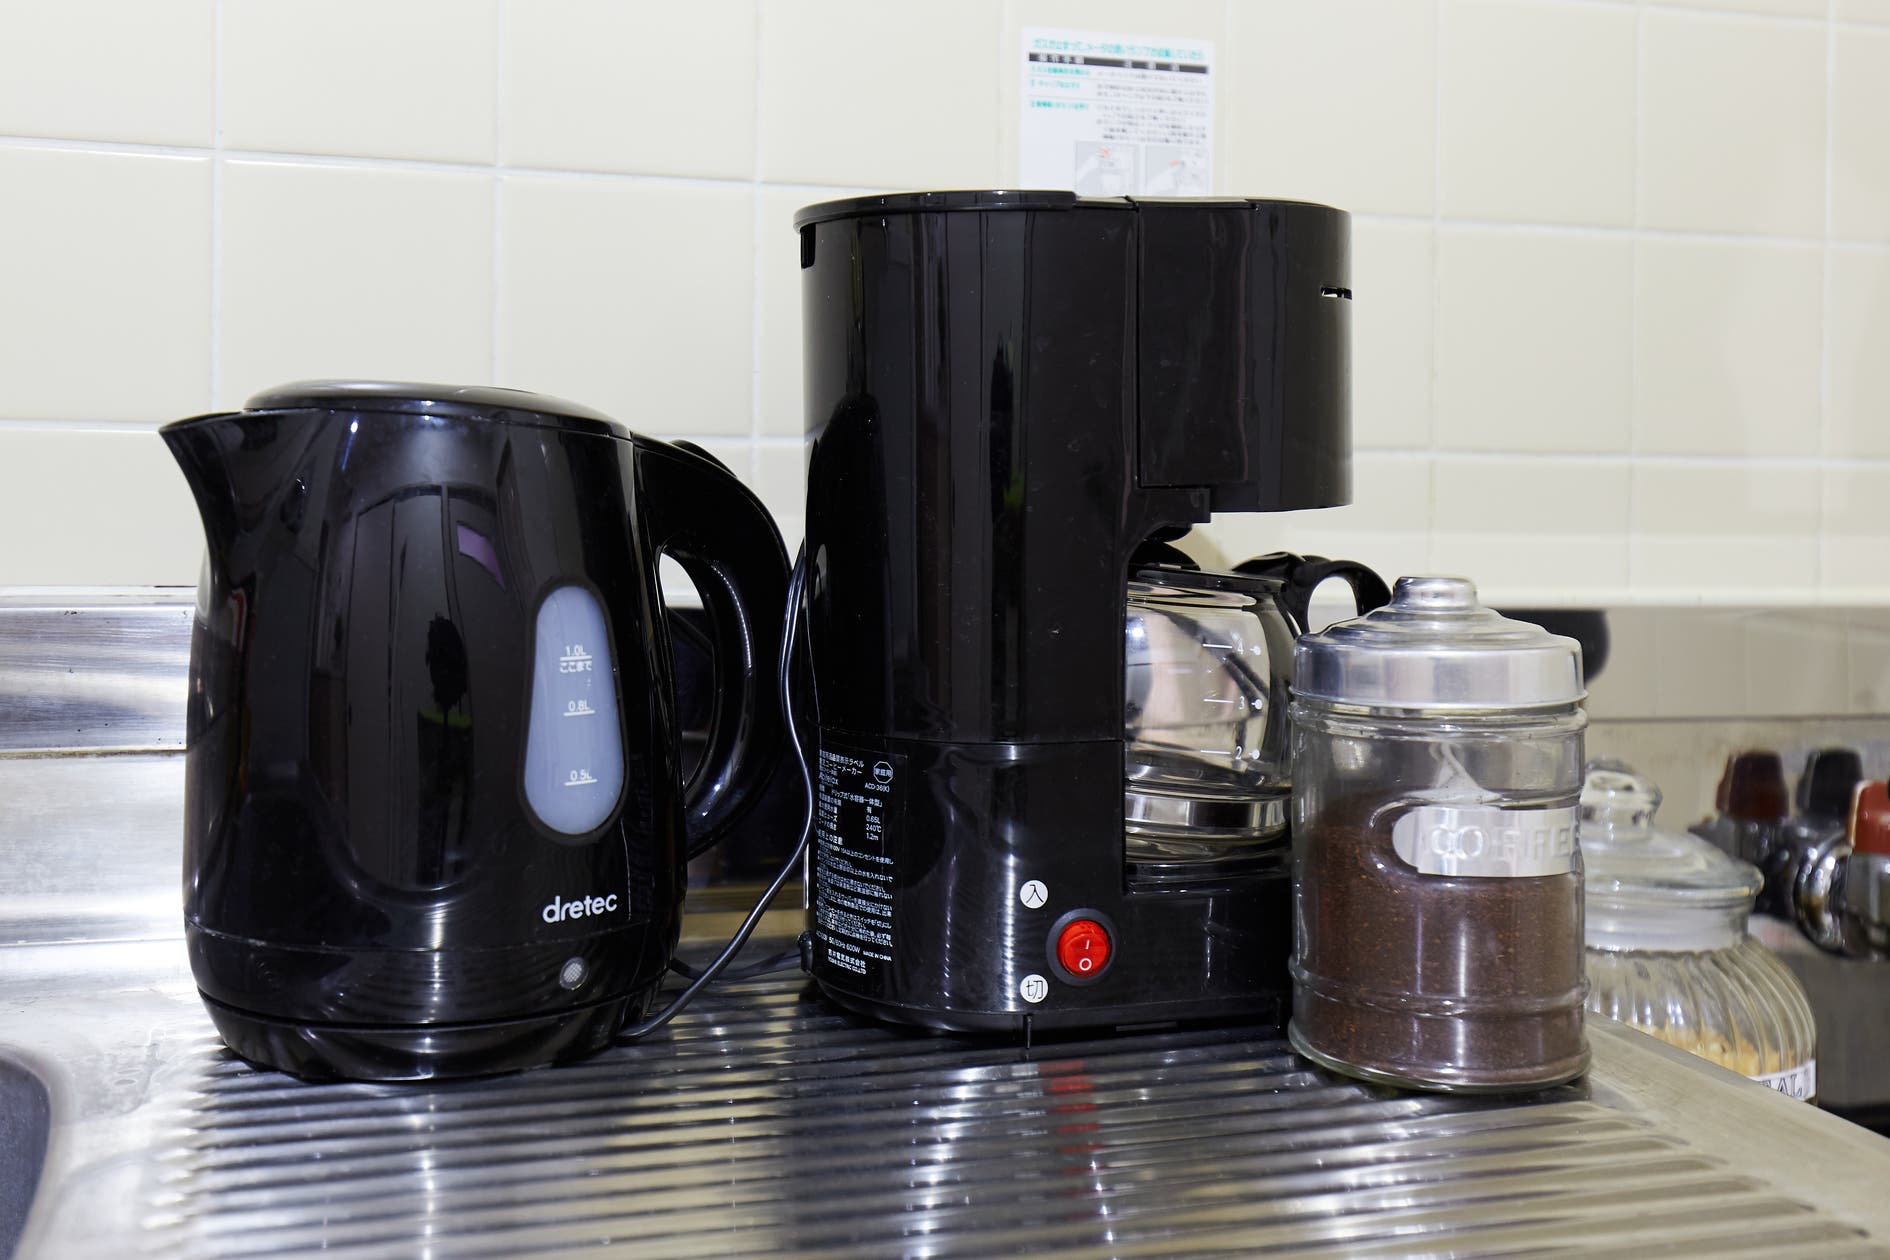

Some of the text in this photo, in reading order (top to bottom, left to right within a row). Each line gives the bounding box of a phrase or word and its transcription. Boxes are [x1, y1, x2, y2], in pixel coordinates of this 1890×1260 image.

[565, 644, 587, 656] 1.0L
[560, 660, 592, 673] ここまで
[1239, 695, 1245, 710] 3
[1235, 745, 1243, 760] 2
[1026, 884, 1044, 904] 入
[542, 894, 617, 923] dretec
[1026, 980, 1044, 999] 切
